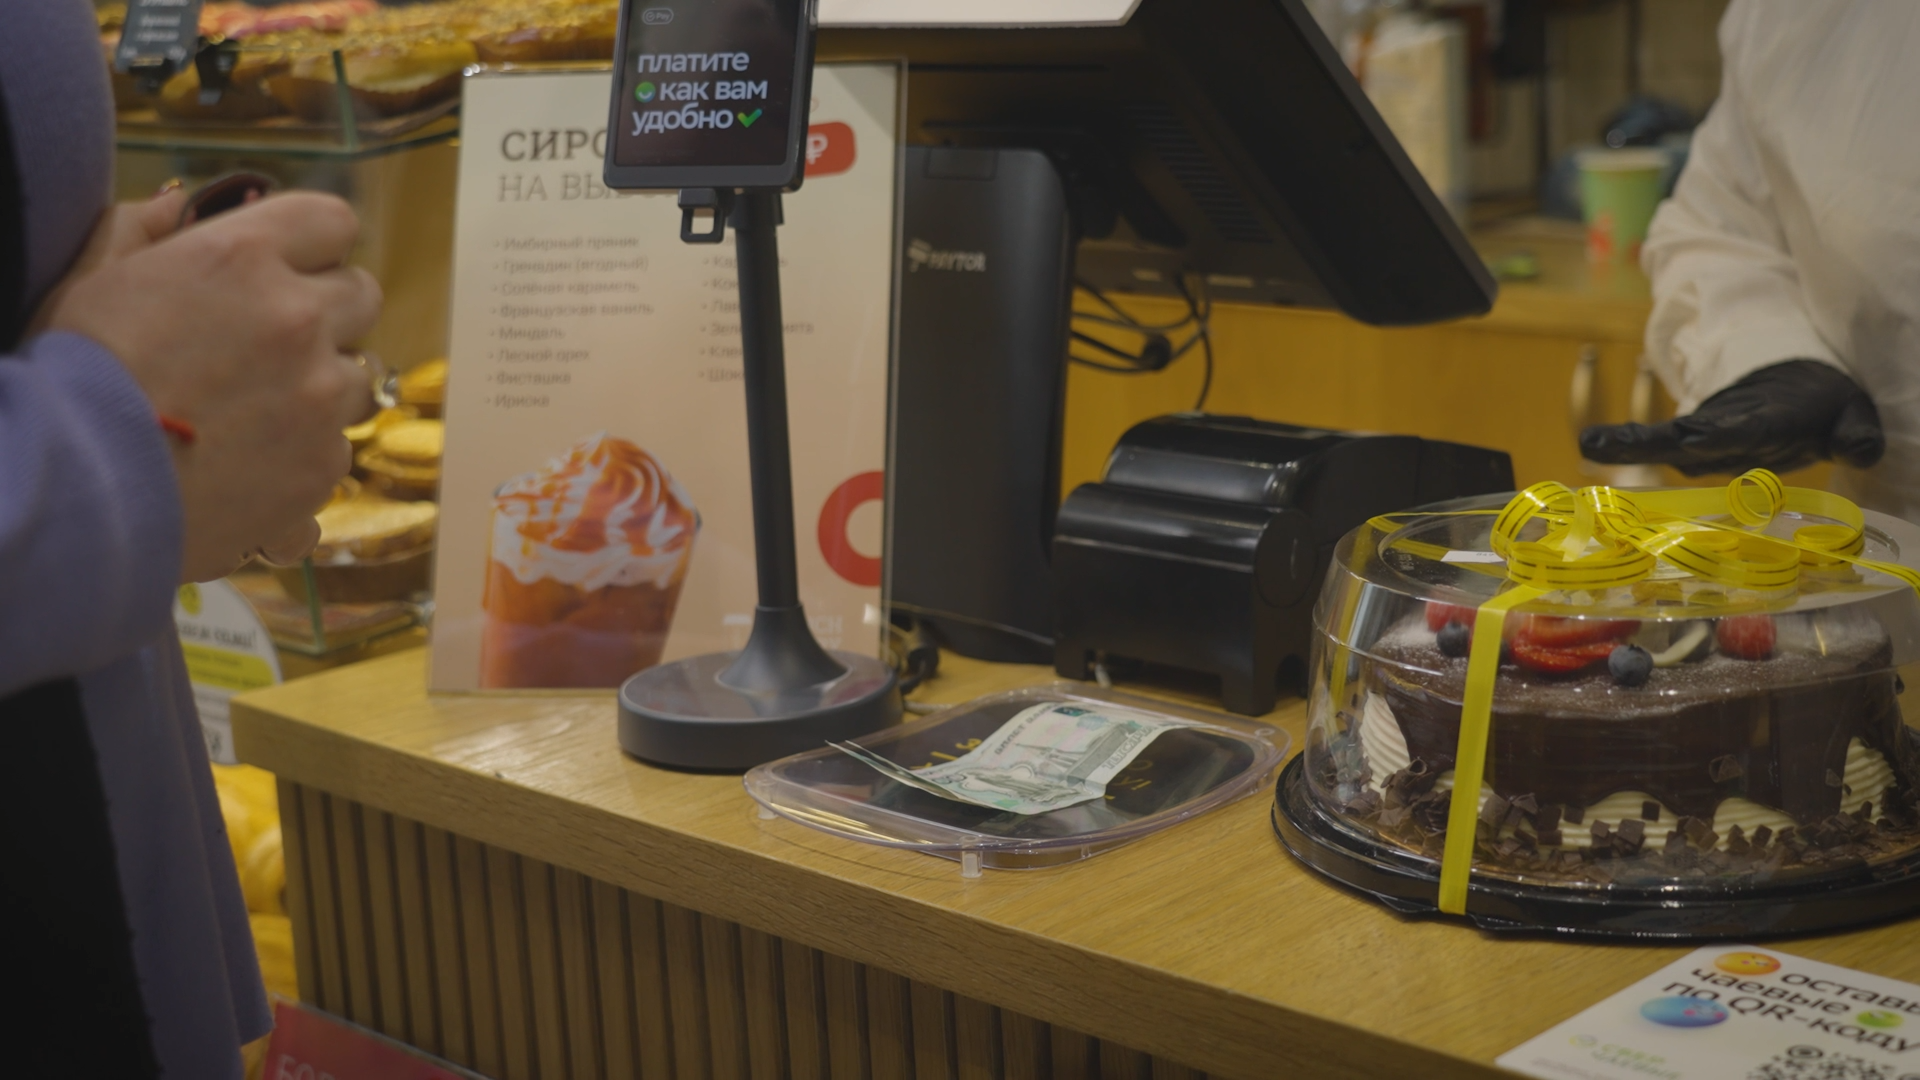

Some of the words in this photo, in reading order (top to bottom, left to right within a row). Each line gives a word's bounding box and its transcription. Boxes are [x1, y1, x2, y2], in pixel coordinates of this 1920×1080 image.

[656, 12, 671, 21] Pay
[637, 52, 750, 74] платите
[659, 81, 710, 102] как
[714, 79, 769, 101] вам
[631, 101, 734, 136] удобно
[498, 173, 549, 202] НА
[503, 236, 583, 251] Имбирный
[498, 326, 567, 341] Миндаль
[494, 394, 551, 410] Ириска
[1691, 968, 1851, 1015] чаевые
[1662, 982, 1720, 1001] по
[1728, 996, 1920, 1054] QR-коду
